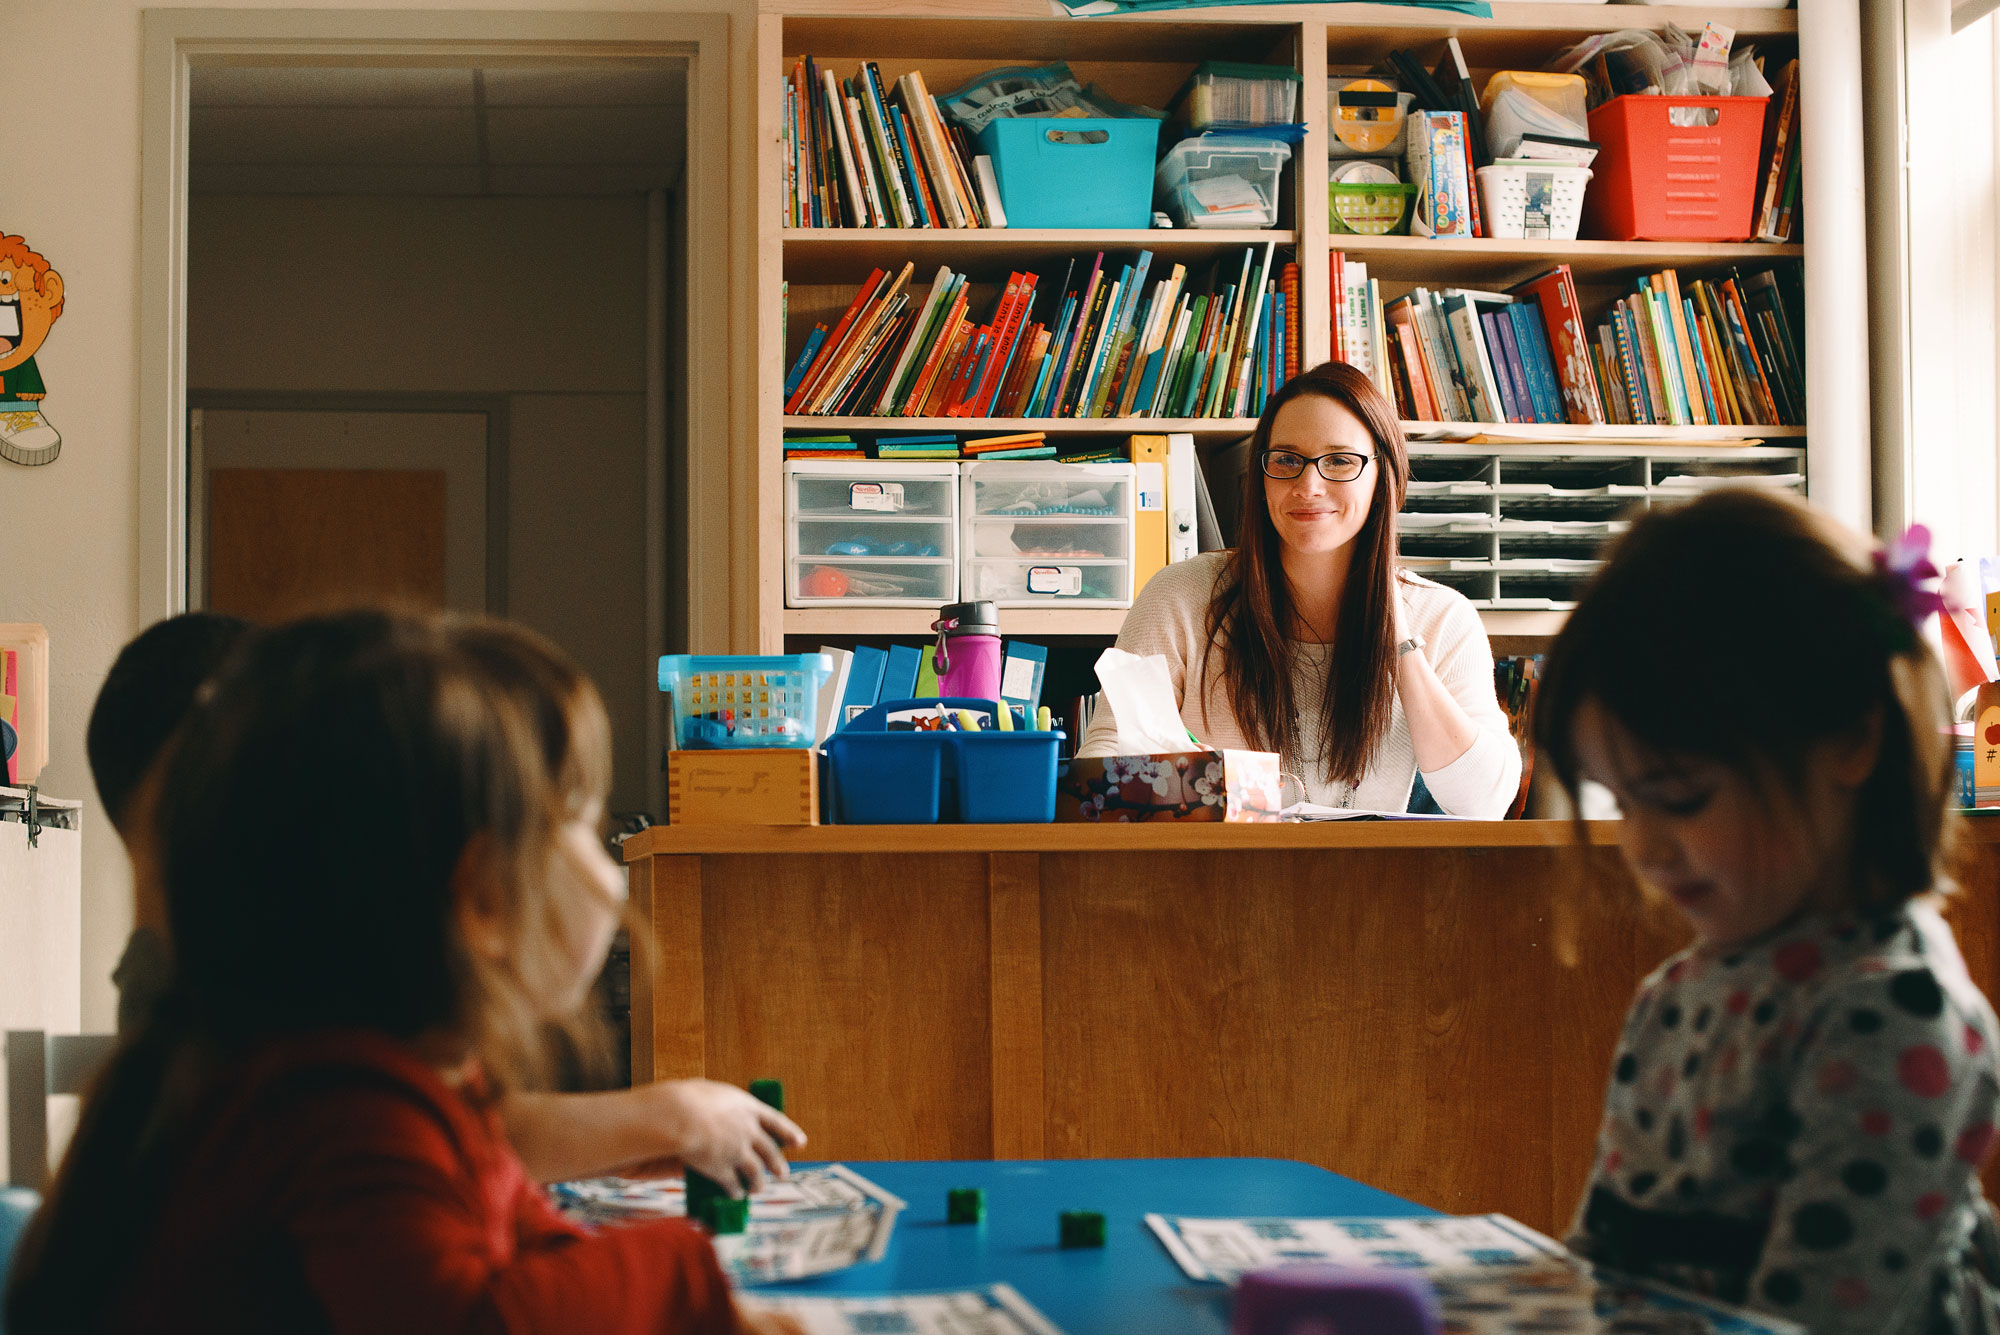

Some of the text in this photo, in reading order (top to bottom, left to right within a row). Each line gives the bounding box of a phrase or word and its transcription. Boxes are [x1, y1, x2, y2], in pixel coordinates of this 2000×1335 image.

[993, 324, 1001, 334] DE
[997, 301, 1010, 323] PLUIE
[998, 301, 1024, 355] JOUR DE PLUIE
[1066, 455, 1087, 463] Crayola
